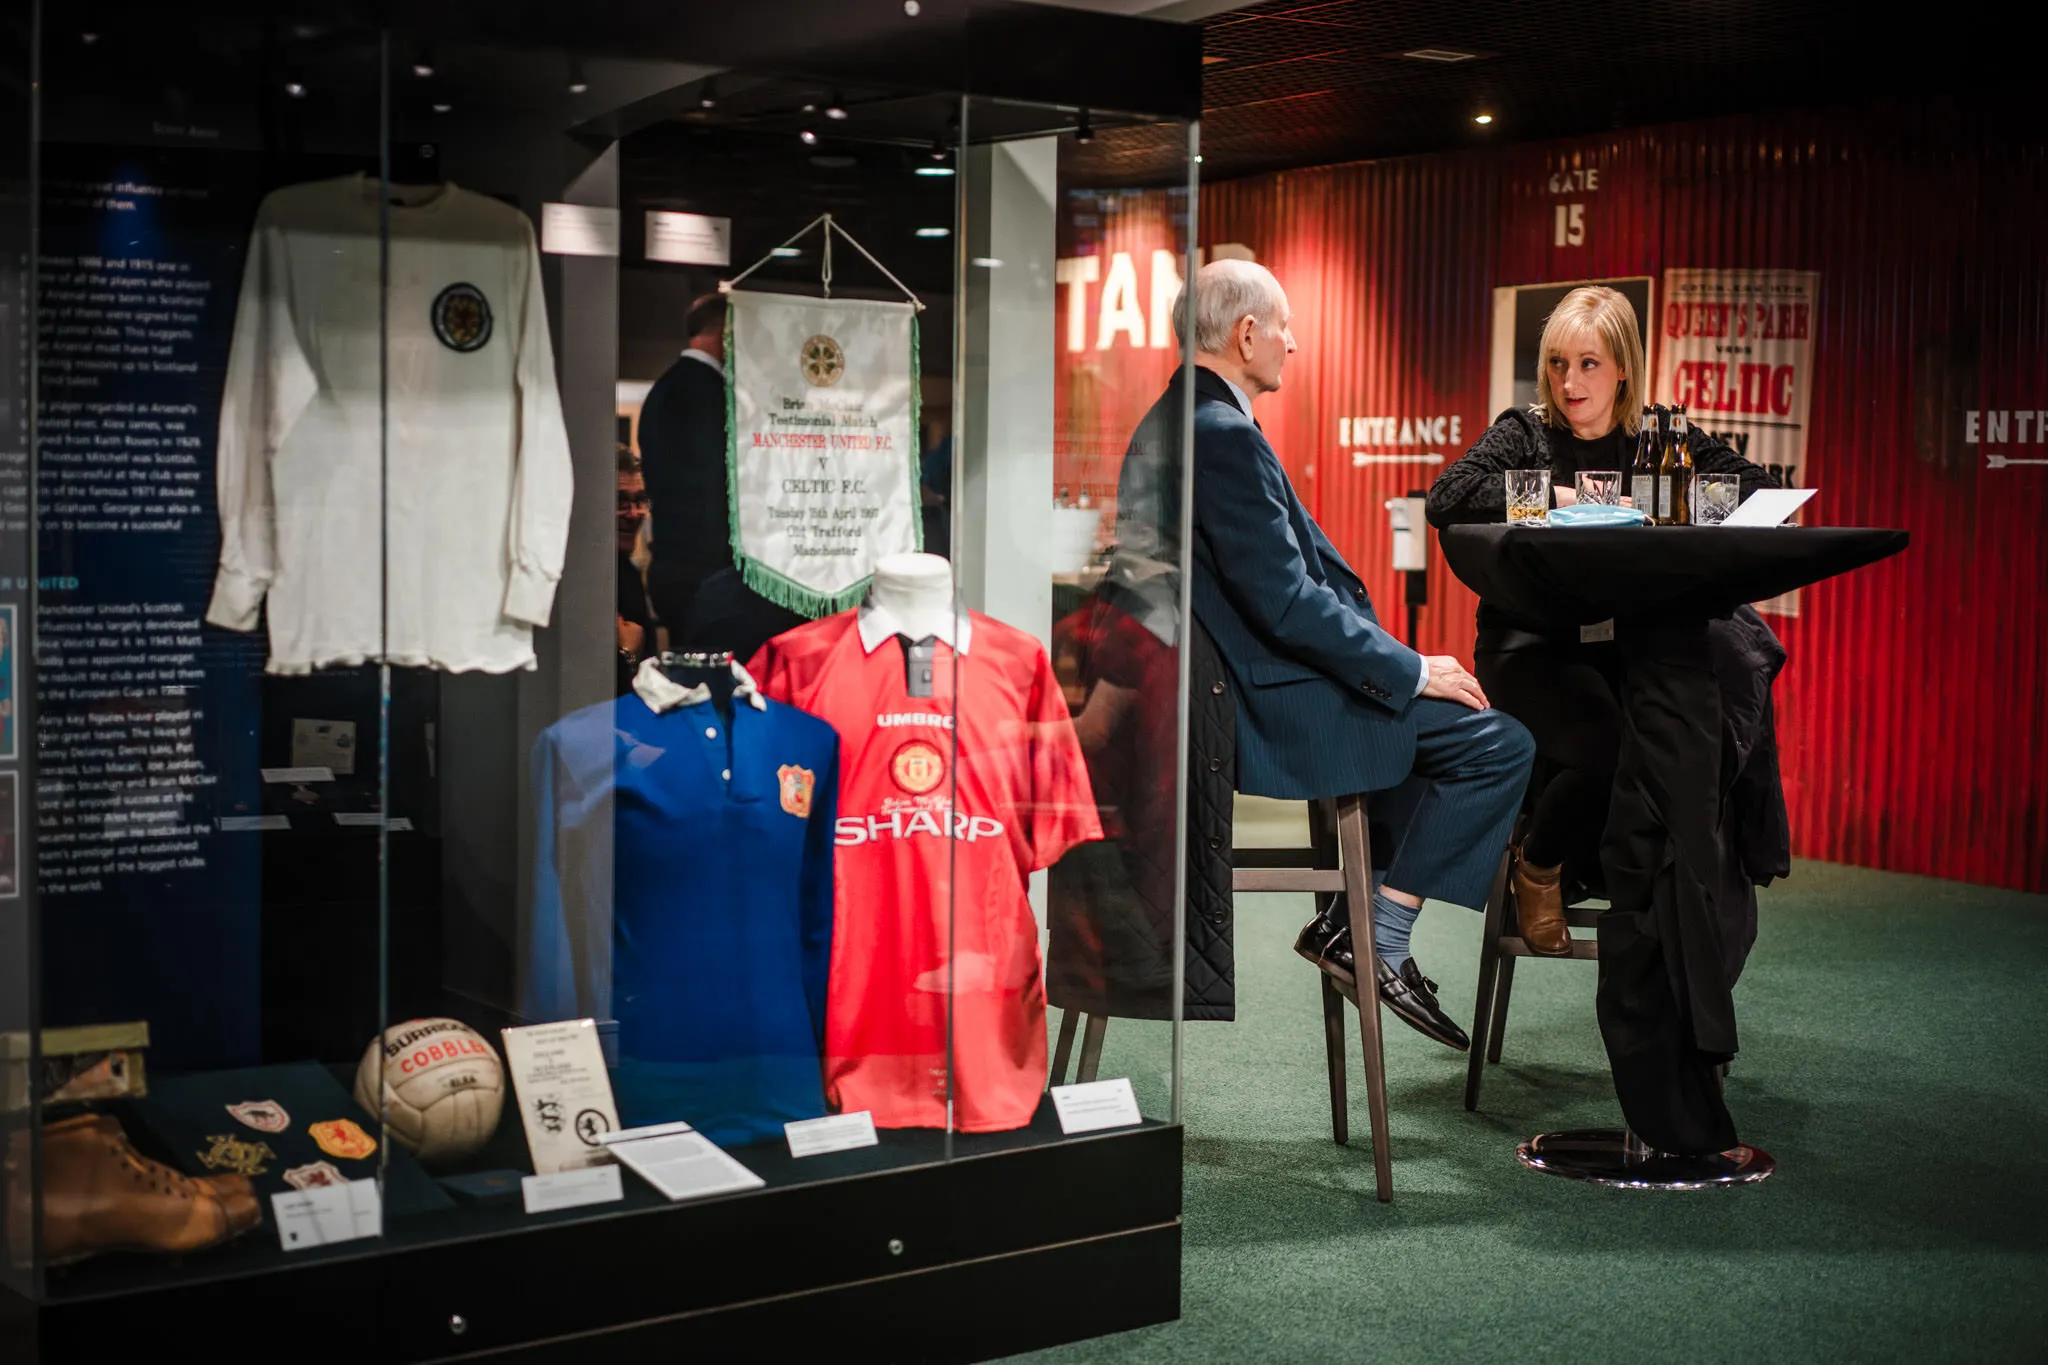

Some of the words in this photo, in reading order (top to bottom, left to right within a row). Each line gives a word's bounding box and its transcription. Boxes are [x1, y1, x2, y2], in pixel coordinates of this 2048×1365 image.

[1549, 168, 1599, 193] GATE
[1555, 203, 1585, 248] 15
[1755, 302, 1809, 340] PARK
[1674, 361, 1794, 416] CELTIC
[768, 413, 836, 427] Testimonial
[1339, 414, 1462, 447] ENTRANCE
[752, 432, 826, 448] MANCHESTER
[831, 434, 872, 449] UNITED
[782, 479, 836, 494] CELTIC
[842, 480, 866, 494] F.C.
[812, 525, 862, 537] Trafford
[793, 545, 858, 557] Manchester
[834, 811, 1004, 846] SHARP
